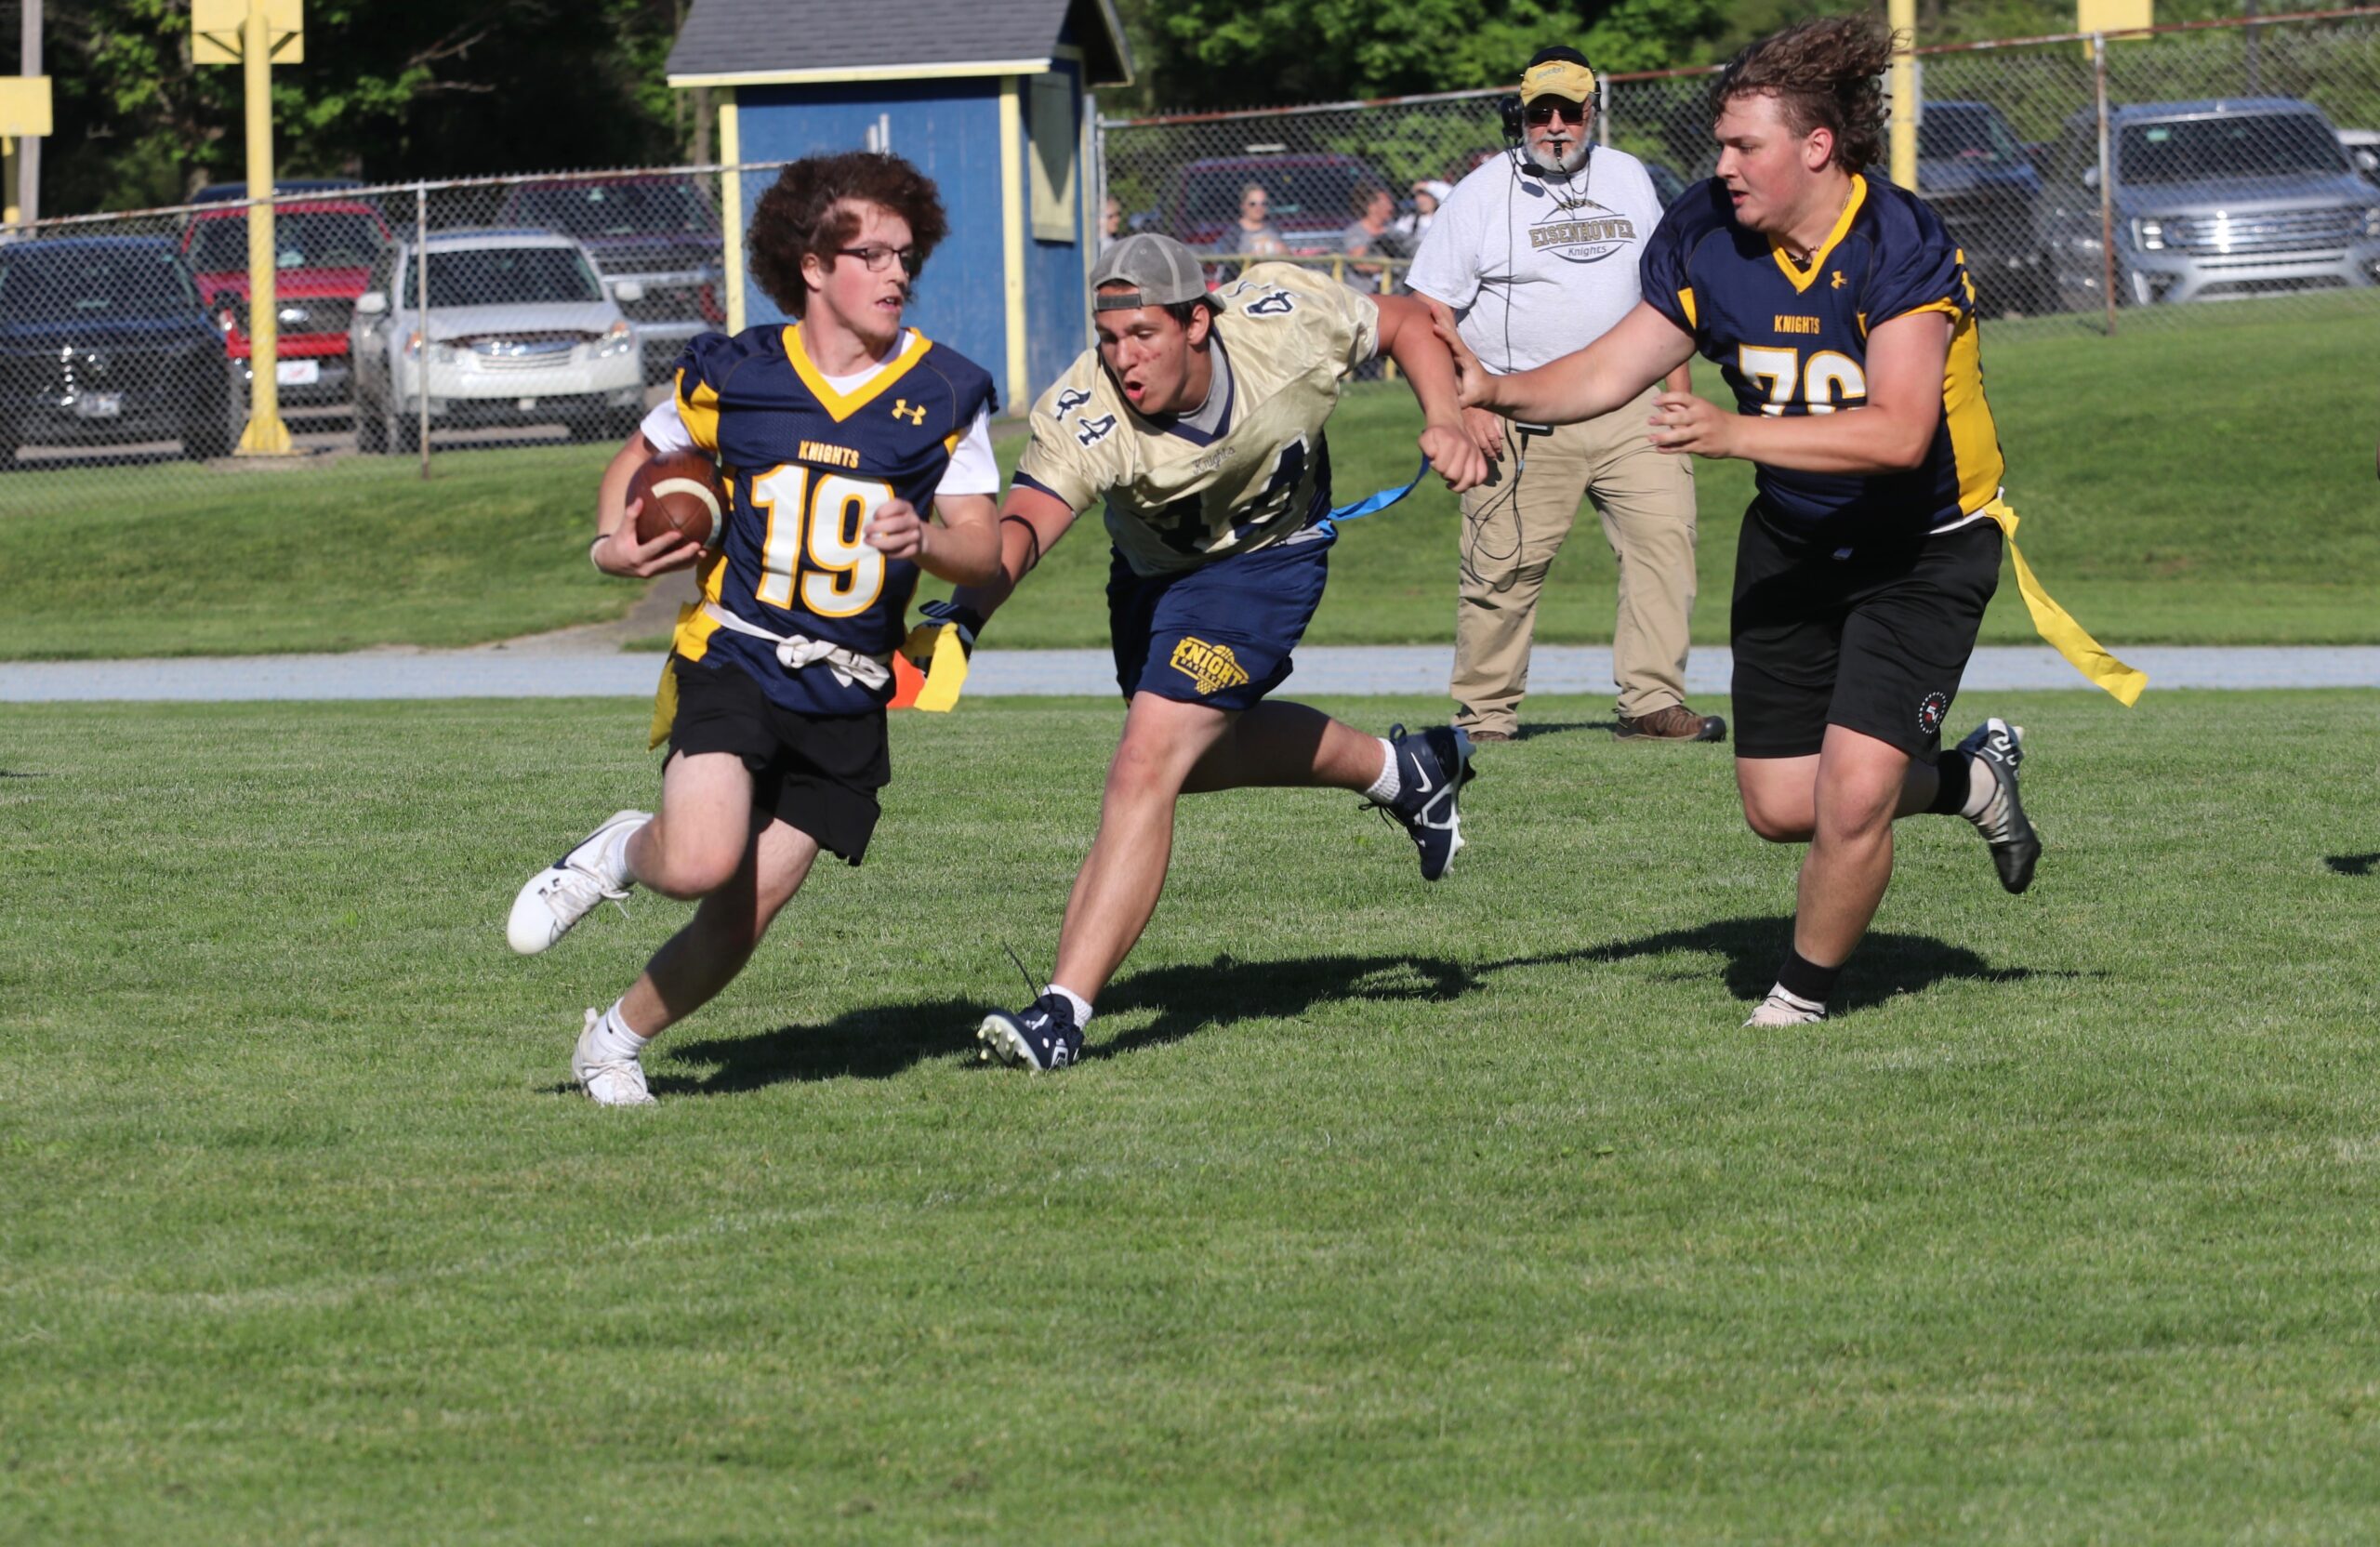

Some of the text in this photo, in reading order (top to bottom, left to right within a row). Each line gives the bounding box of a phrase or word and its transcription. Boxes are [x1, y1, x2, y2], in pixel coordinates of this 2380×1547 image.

[1528, 218, 1636, 248] EISENHOWER
[1567, 245, 1606, 257] Knights
[1774, 314, 1820, 335] KNIGHTS
[798, 440, 860, 469] KNIGHTS
[1192, 445, 1236, 476] Knights
[750, 461, 895, 618] 19
